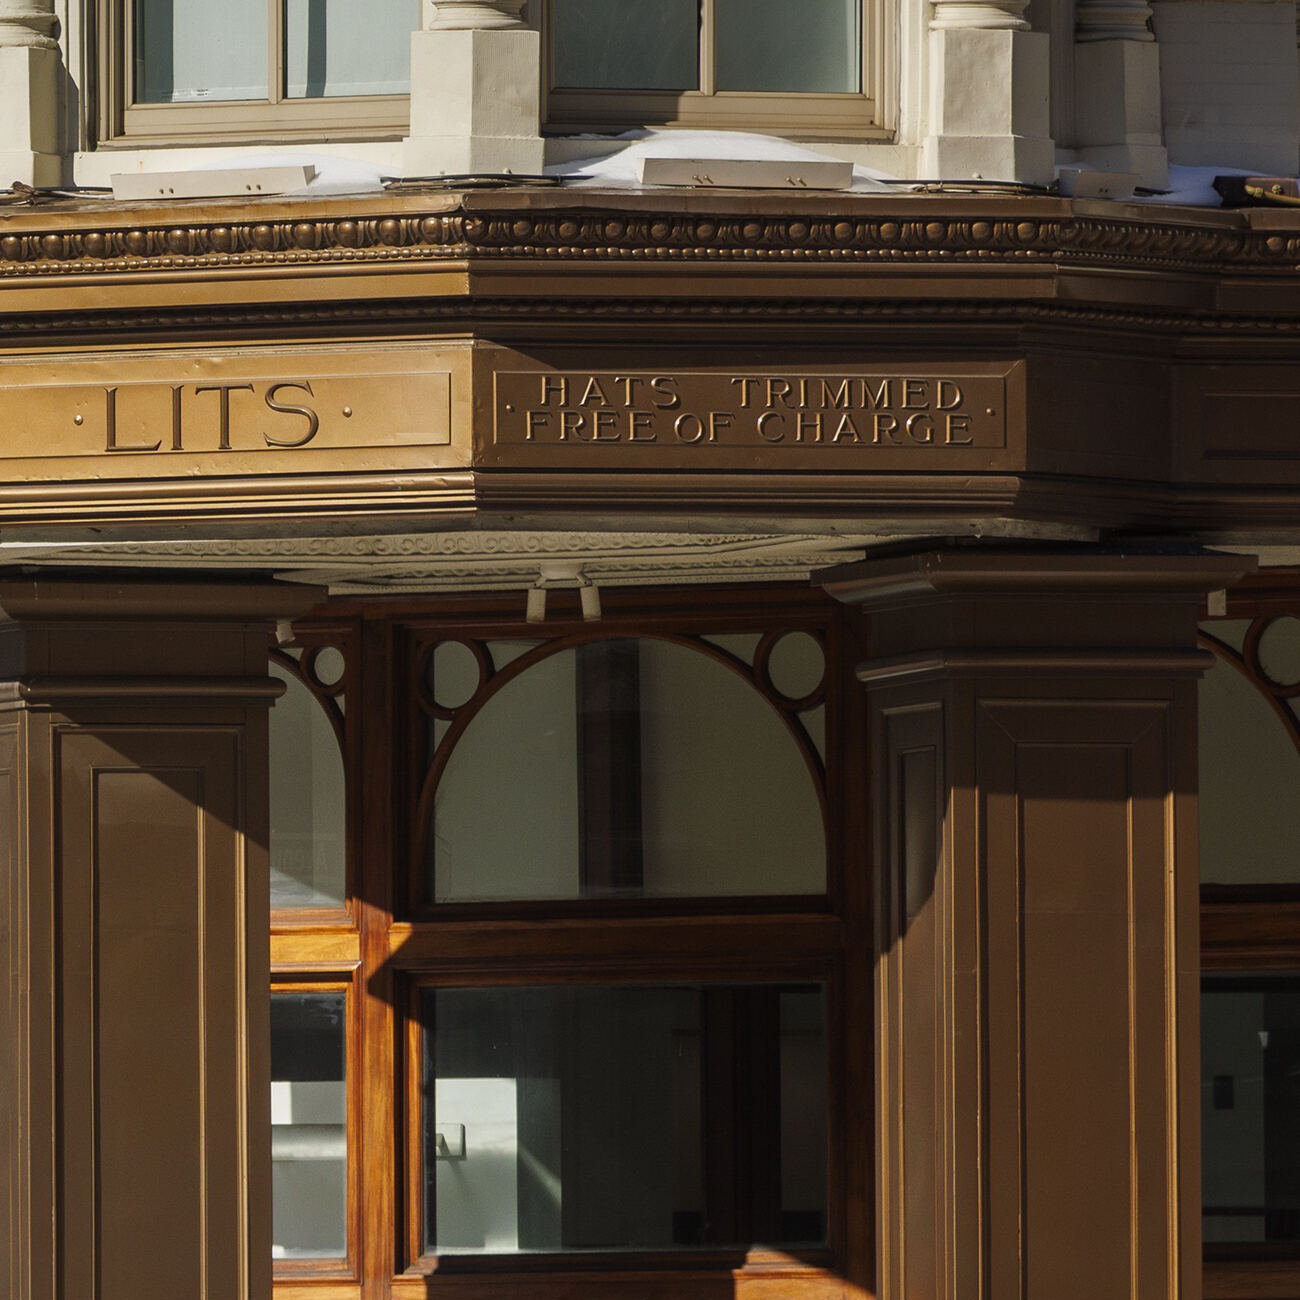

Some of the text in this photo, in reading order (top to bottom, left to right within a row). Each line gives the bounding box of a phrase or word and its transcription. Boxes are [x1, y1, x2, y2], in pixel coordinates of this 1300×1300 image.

[540, 375, 963, 411] HATS TRIMMED
[103, 379, 319, 452] LITS
[524, 410, 975, 446] FREE OF CHARGE
